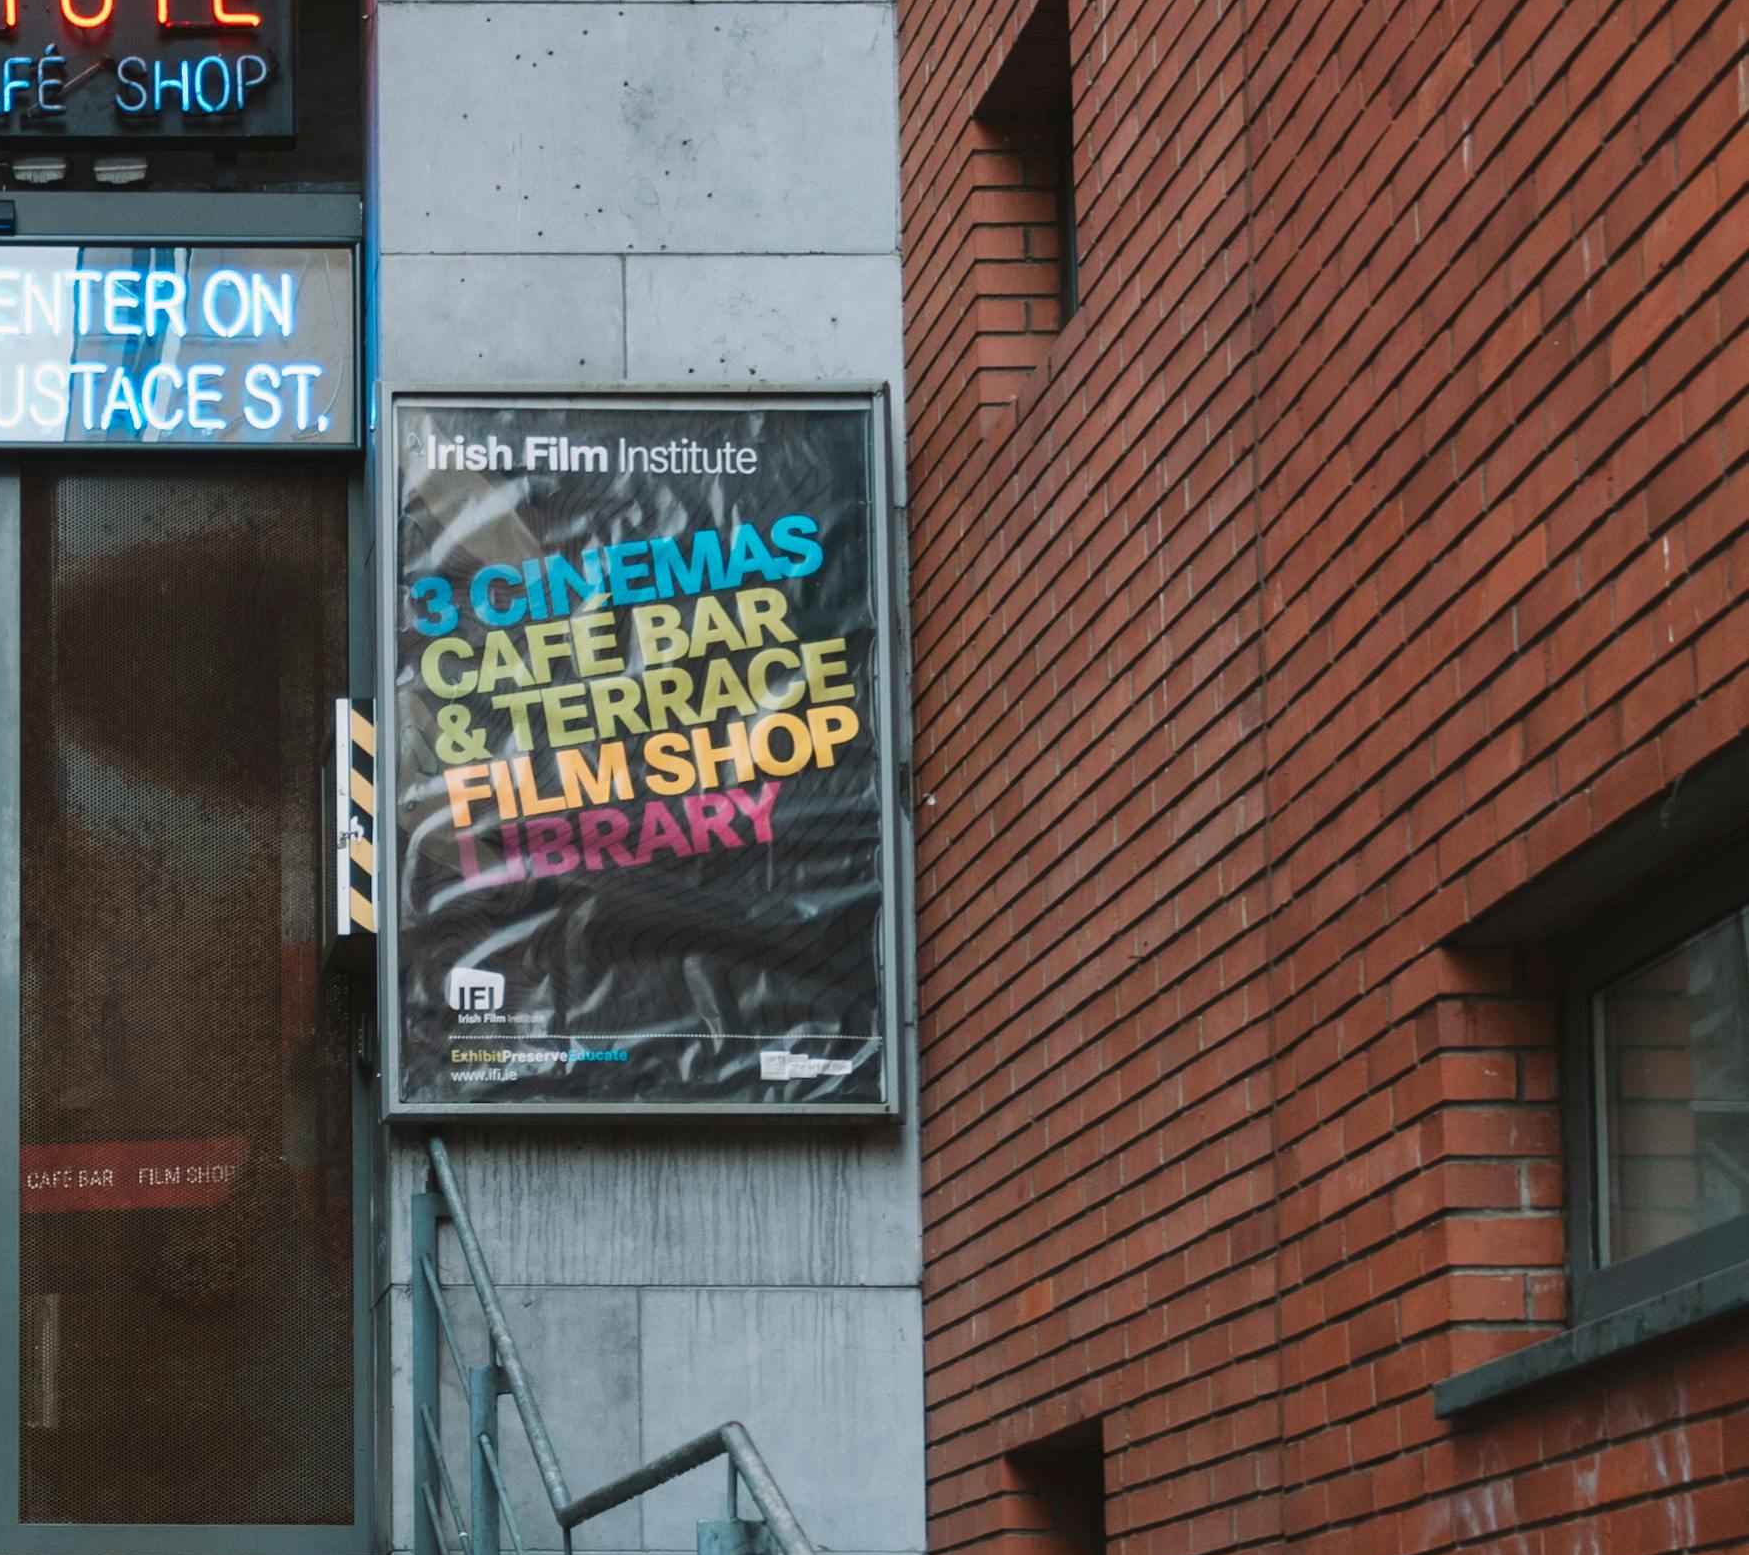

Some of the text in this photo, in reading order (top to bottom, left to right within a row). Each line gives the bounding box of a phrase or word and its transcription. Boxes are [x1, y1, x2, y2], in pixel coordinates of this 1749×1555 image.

[115, 52, 268, 114] SHOP
[202, 268, 293, 338] ON
[242, 361, 329, 433] ST.
[426, 433, 758, 475] Irish Film Institute
[410, 513, 824, 636] 3 CINEMAS
[420, 586, 798, 698] CAFÉ BAR
[434, 638, 856, 765] & TERRACE
[443, 705, 861, 829] FILM SHOP
[453, 781, 783, 891] LIBRARY
[458, 1013, 482, 1024] Irish
[484, 1013, 507, 1024] Film
[459, 986, 495, 1011] IFI
[78, 1168, 114, 1189] BAR
[138, 1166, 181, 1187] FILM
[185, 1164, 236, 1185] SHOP
